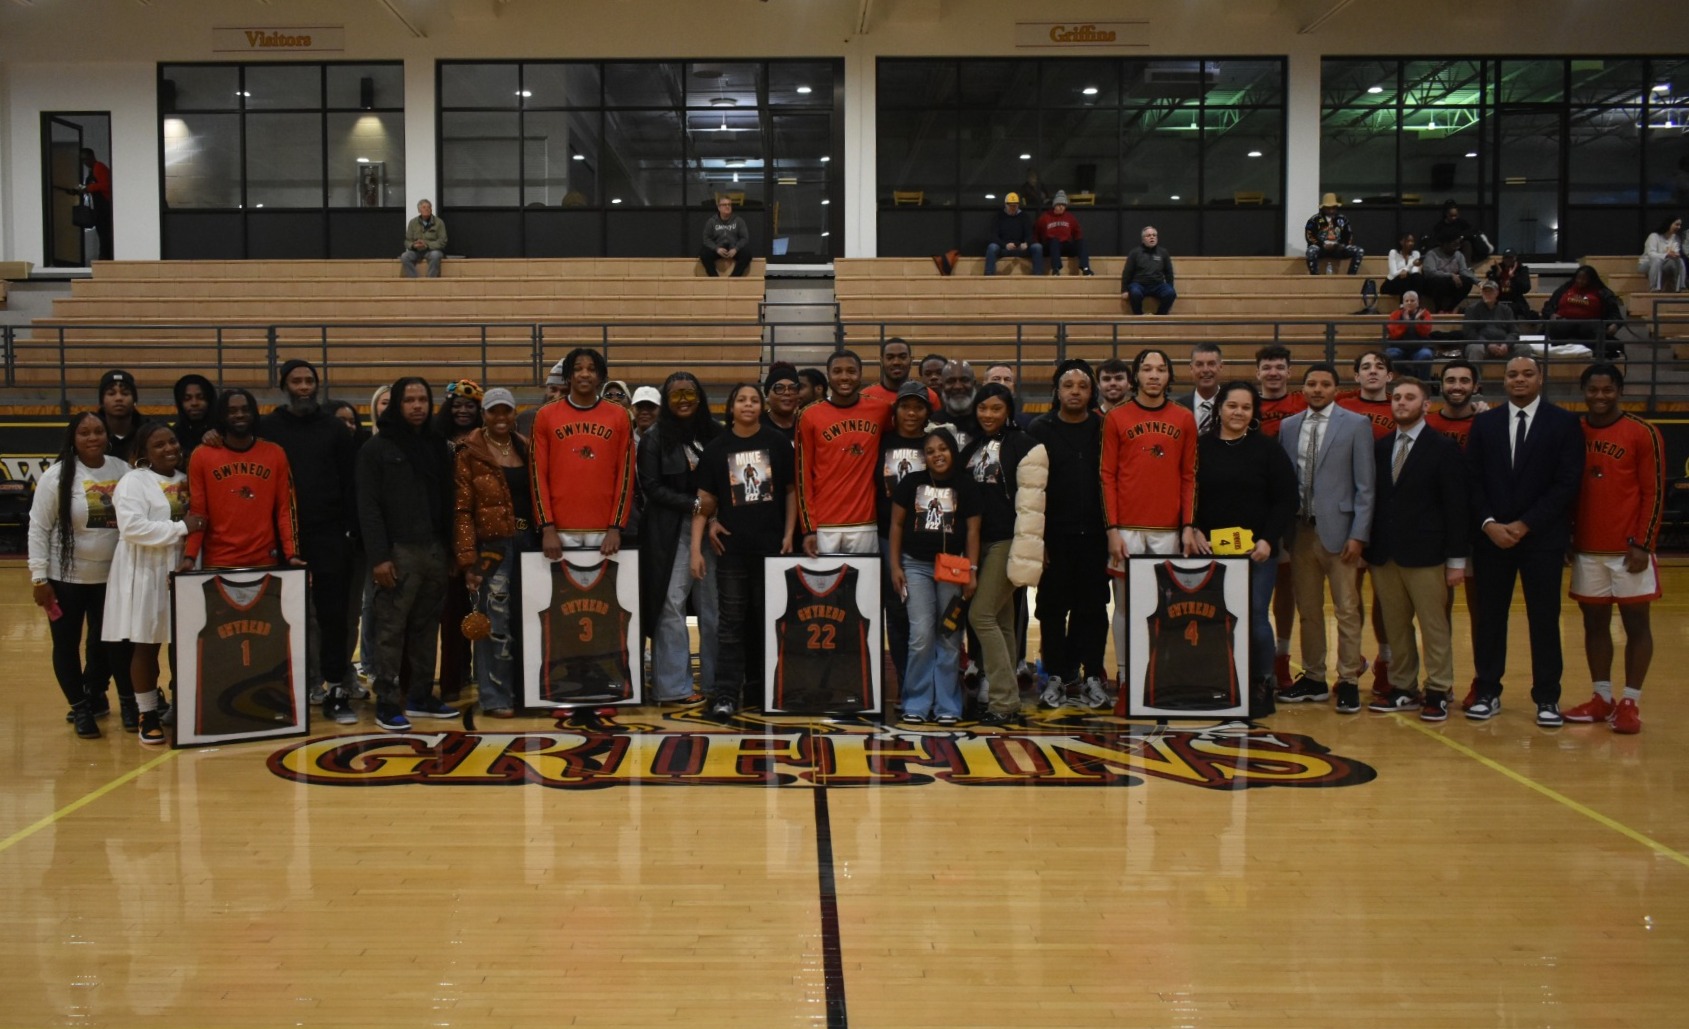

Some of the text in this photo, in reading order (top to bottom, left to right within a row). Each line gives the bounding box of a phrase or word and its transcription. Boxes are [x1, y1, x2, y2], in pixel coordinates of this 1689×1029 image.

[244, 31, 312, 48] Visitors
[1049, 25, 1116, 43] Griffins
[554, 421, 613, 441] GWYNEDD
[821, 419, 879, 442] GWYNEDD
[1126, 421, 1181, 441] GWYNEDD
[735, 451, 762, 466] MIKE
[892, 449, 919, 460] MIKE
[1586, 440, 1626, 460] YNEDD
[212, 462, 272, 481] GWYNEDD
[924, 485, 951, 499] MIKE
[561, 598, 609, 616] GWYNEDD
[797, 604, 846, 623] GWYNEDD
[578, 616, 593, 642] 3
[807, 623, 836, 650] 22
[1184, 620, 1199, 647] 4
[240, 639, 251, 667] 1
[266, 731, 1376, 789] GRIFFINS
